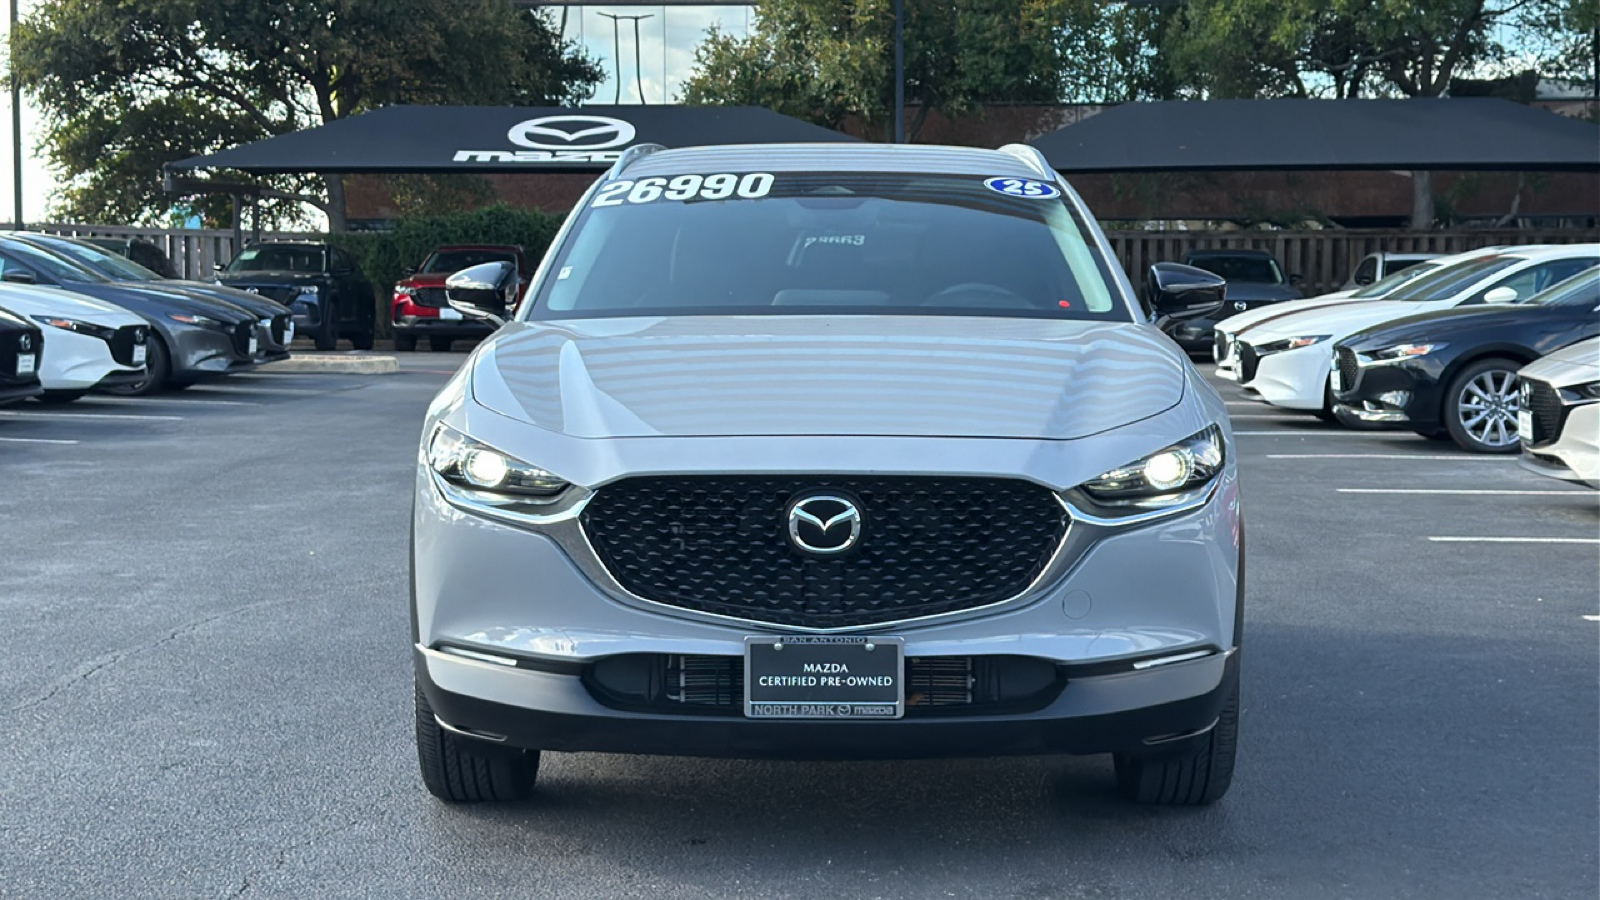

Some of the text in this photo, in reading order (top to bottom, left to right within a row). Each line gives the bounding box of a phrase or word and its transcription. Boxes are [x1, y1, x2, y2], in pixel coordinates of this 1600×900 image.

[452, 150, 624, 162] mazd
[591, 173, 775, 208] 26990
[1002, 179, 1043, 195] 25
[803, 663, 849, 673] MAZDA
[759, 676, 893, 686] CERTIFIED PRE-OWNED
[754, 705, 894, 715] NORTH PARK mazda
